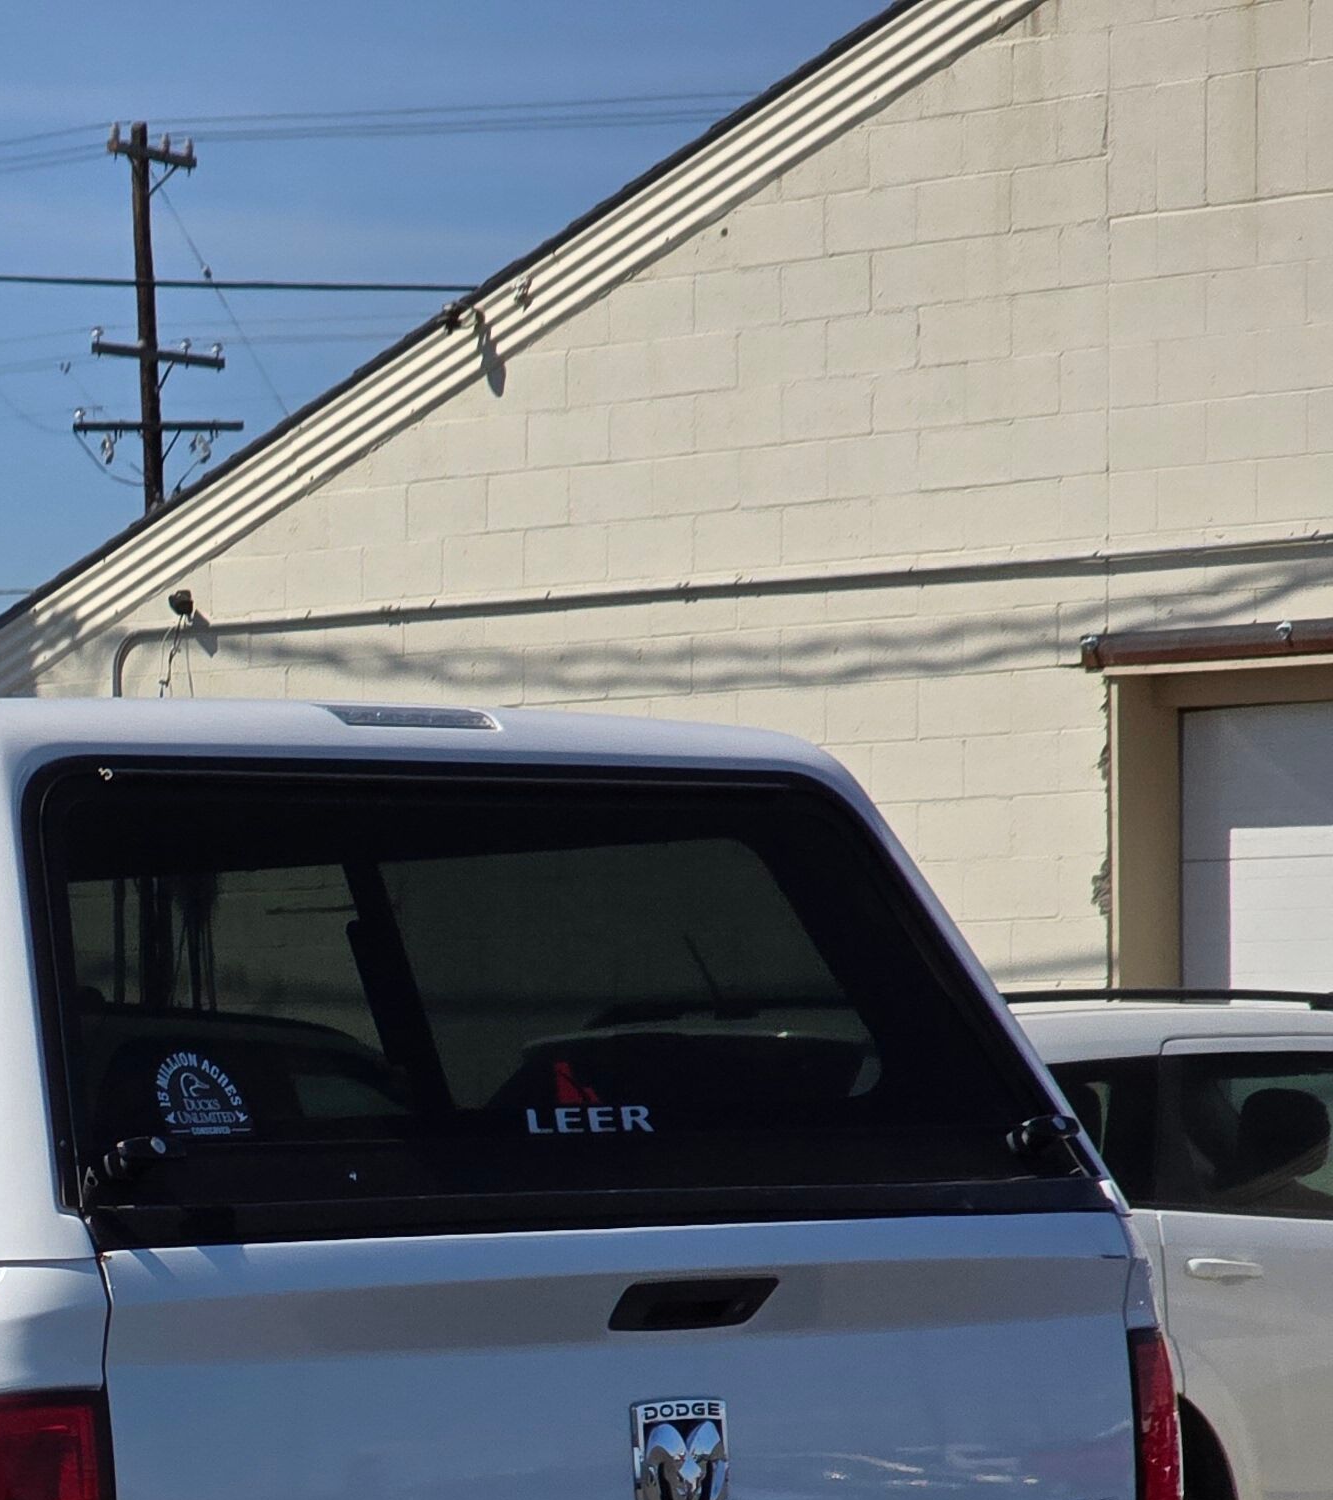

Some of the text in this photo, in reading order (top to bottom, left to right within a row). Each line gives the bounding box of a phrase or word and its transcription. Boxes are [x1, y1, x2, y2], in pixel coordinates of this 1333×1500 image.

[156, 1052, 198, 1090] MILLION
[201, 1059, 243, 1106] ACRES
[183, 1098, 222, 1111] DUCKS
[176, 1111, 236, 1124] UNLIMITED
[526, 1105, 654, 1134] LEER
[644, 1403, 720, 1421] DODGE
